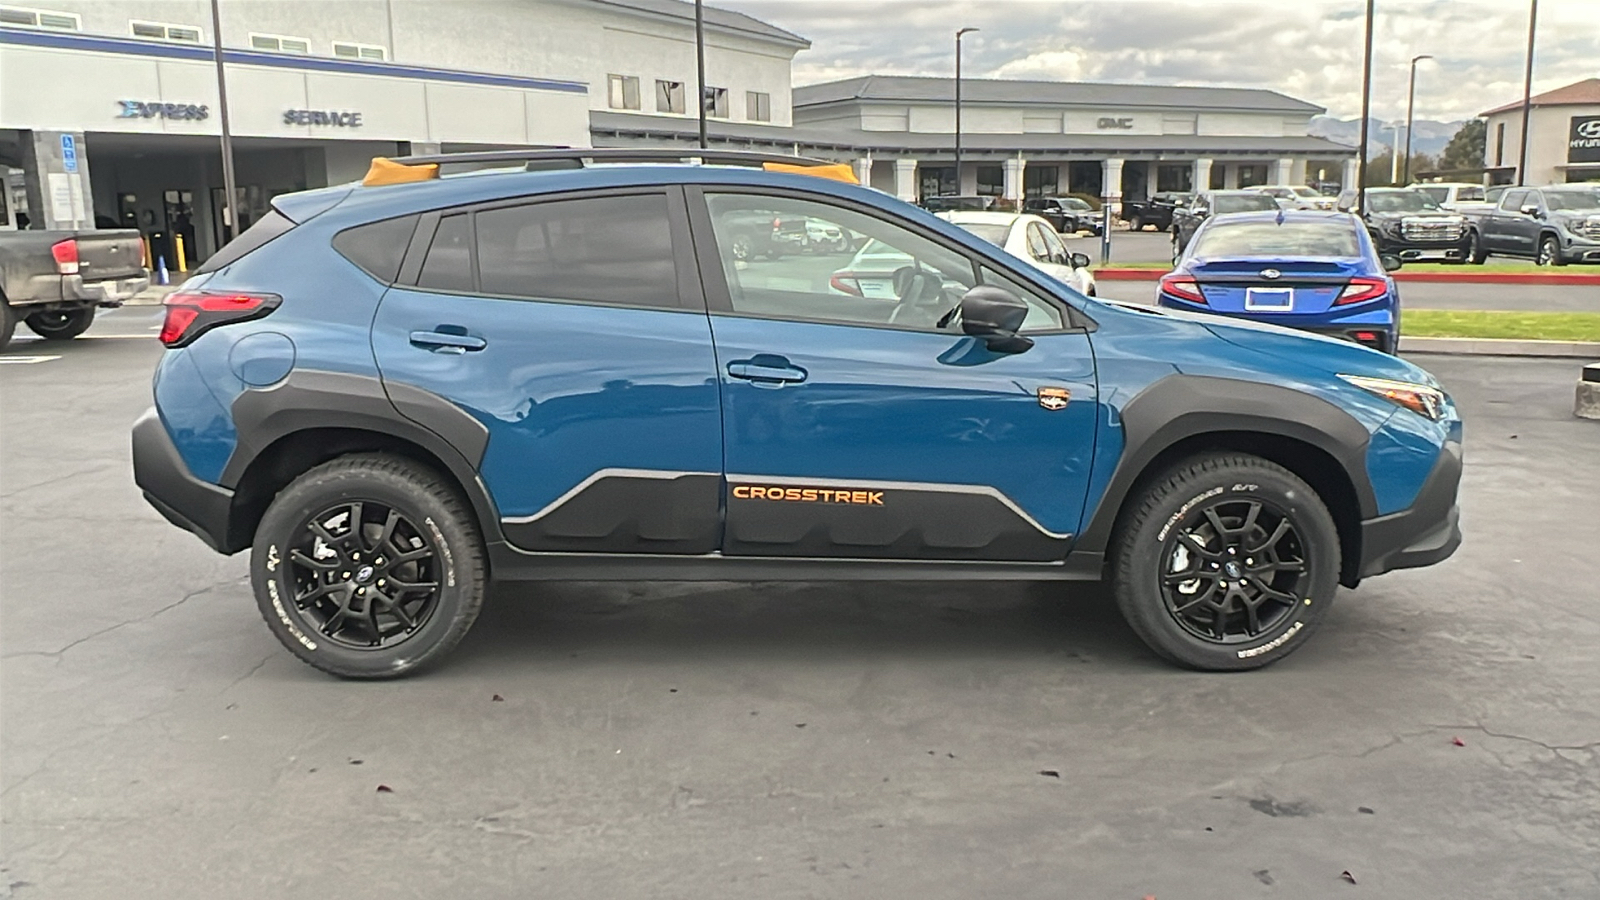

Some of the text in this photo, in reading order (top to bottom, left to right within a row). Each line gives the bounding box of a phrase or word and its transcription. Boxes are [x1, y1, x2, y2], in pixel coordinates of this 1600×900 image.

[116, 101, 363, 127] EXPRESS SERVICE
[1097, 117, 1133, 129] GMC
[733, 486, 884, 505] CROSSTREK
